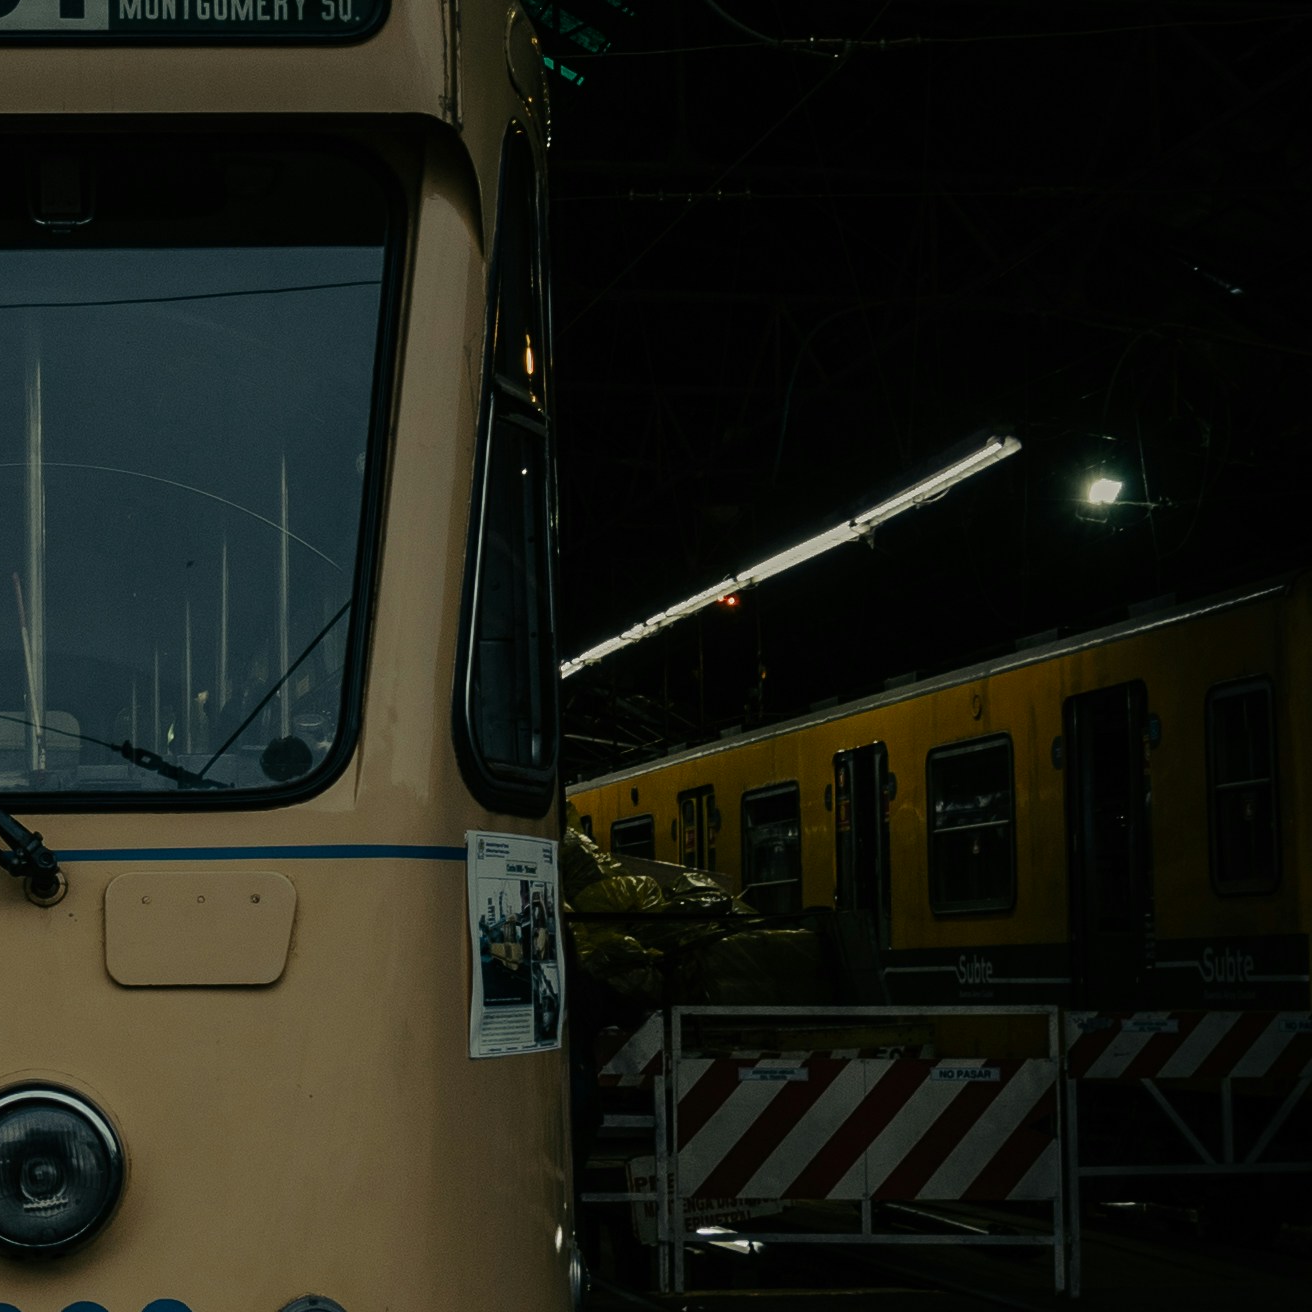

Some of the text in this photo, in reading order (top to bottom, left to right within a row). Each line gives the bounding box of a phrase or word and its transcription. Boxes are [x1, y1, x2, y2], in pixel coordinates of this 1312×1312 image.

[958, 954, 993, 985] Subte
[1201, 946, 1255, 983] Subte
[938, 1069, 992, 1080] NO PASAR
